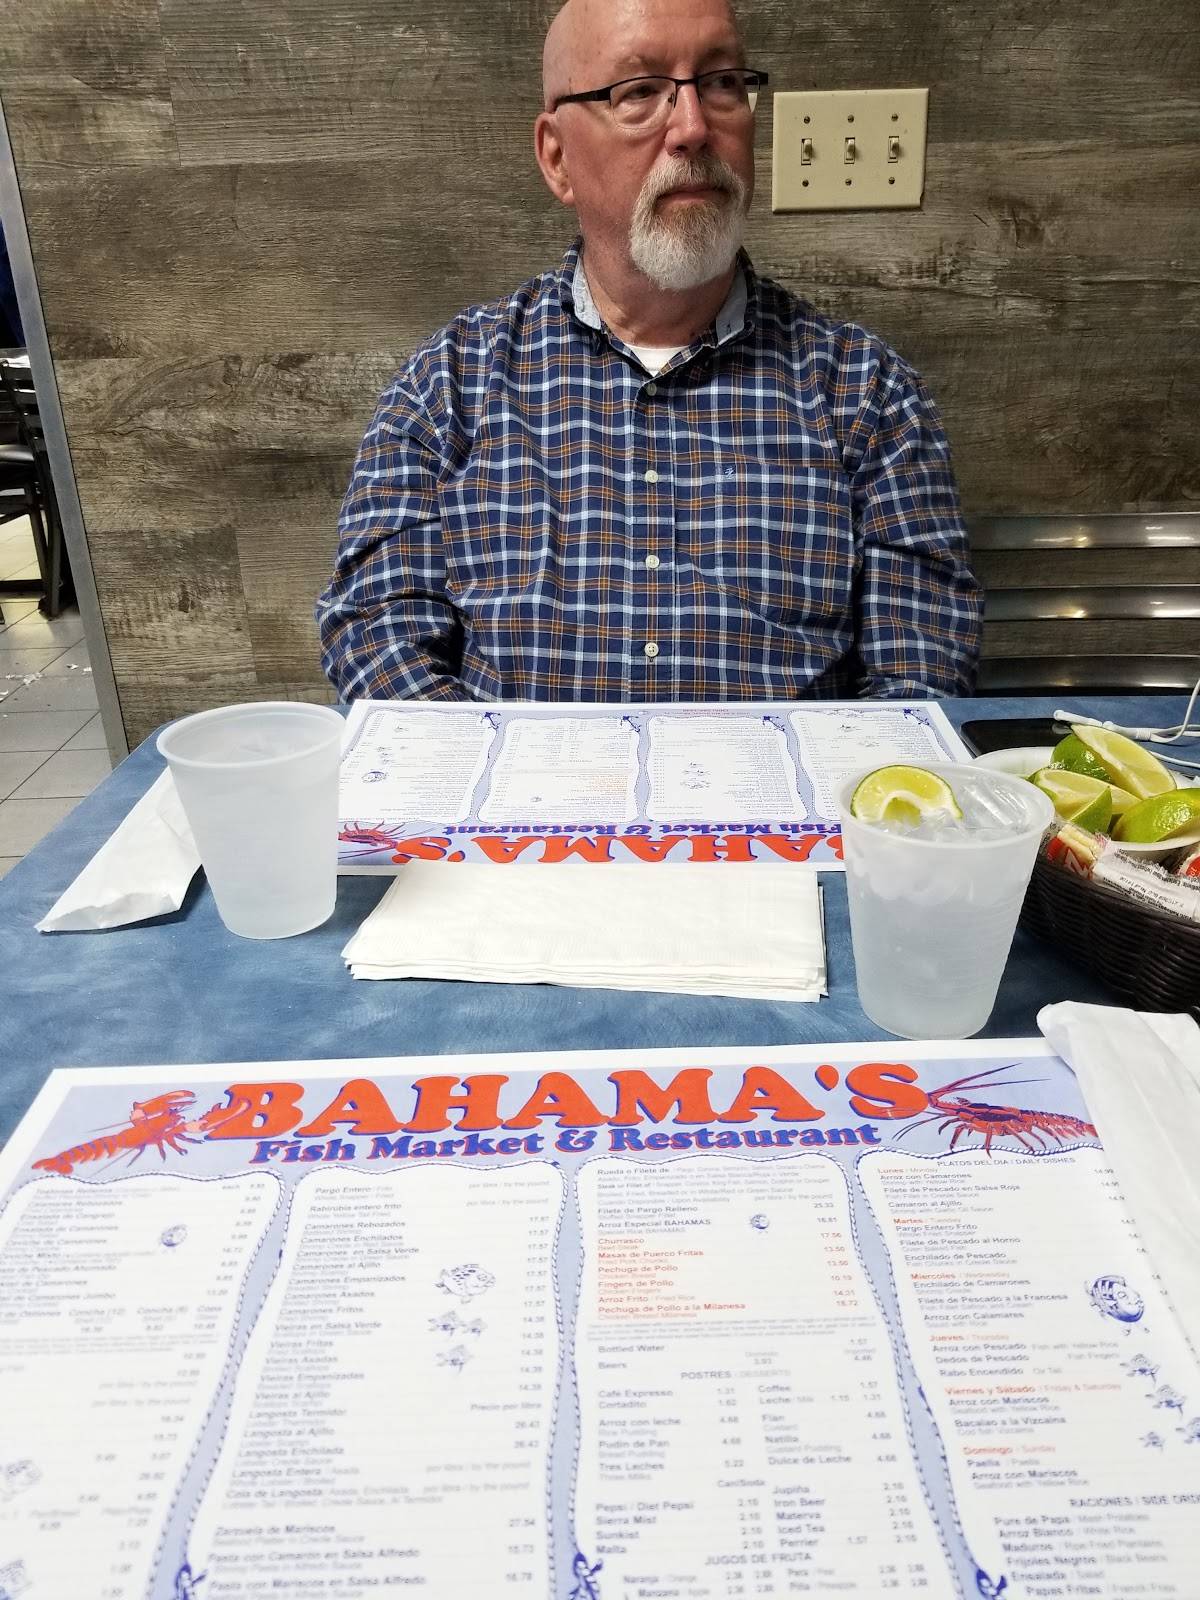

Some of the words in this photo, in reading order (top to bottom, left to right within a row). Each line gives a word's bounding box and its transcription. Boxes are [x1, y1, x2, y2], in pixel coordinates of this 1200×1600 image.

[442, 824, 618, 835] Restaurant
[659, 823, 772, 836] Market
[806, 822, 842, 835] Fish
[206, 1063, 929, 1140] BAHAMA'S
[249, 1140, 356, 1164] Fish
[366, 1132, 544, 1160] Market
[554, 1129, 597, 1152] &
[608, 1123, 882, 1152] Restaurant
[1043, 1157, 1076, 1165] DISHES
[663, 1219, 712, 1227] BAHAMAS
[598, 1237, 645, 1245] Churrasco
[598, 1280, 634, 1289] Fingers
[650, 1278, 675, 1287] Pollo
[598, 1295, 625, 1304] Arroz
[626, 1295, 649, 1304] Frito
